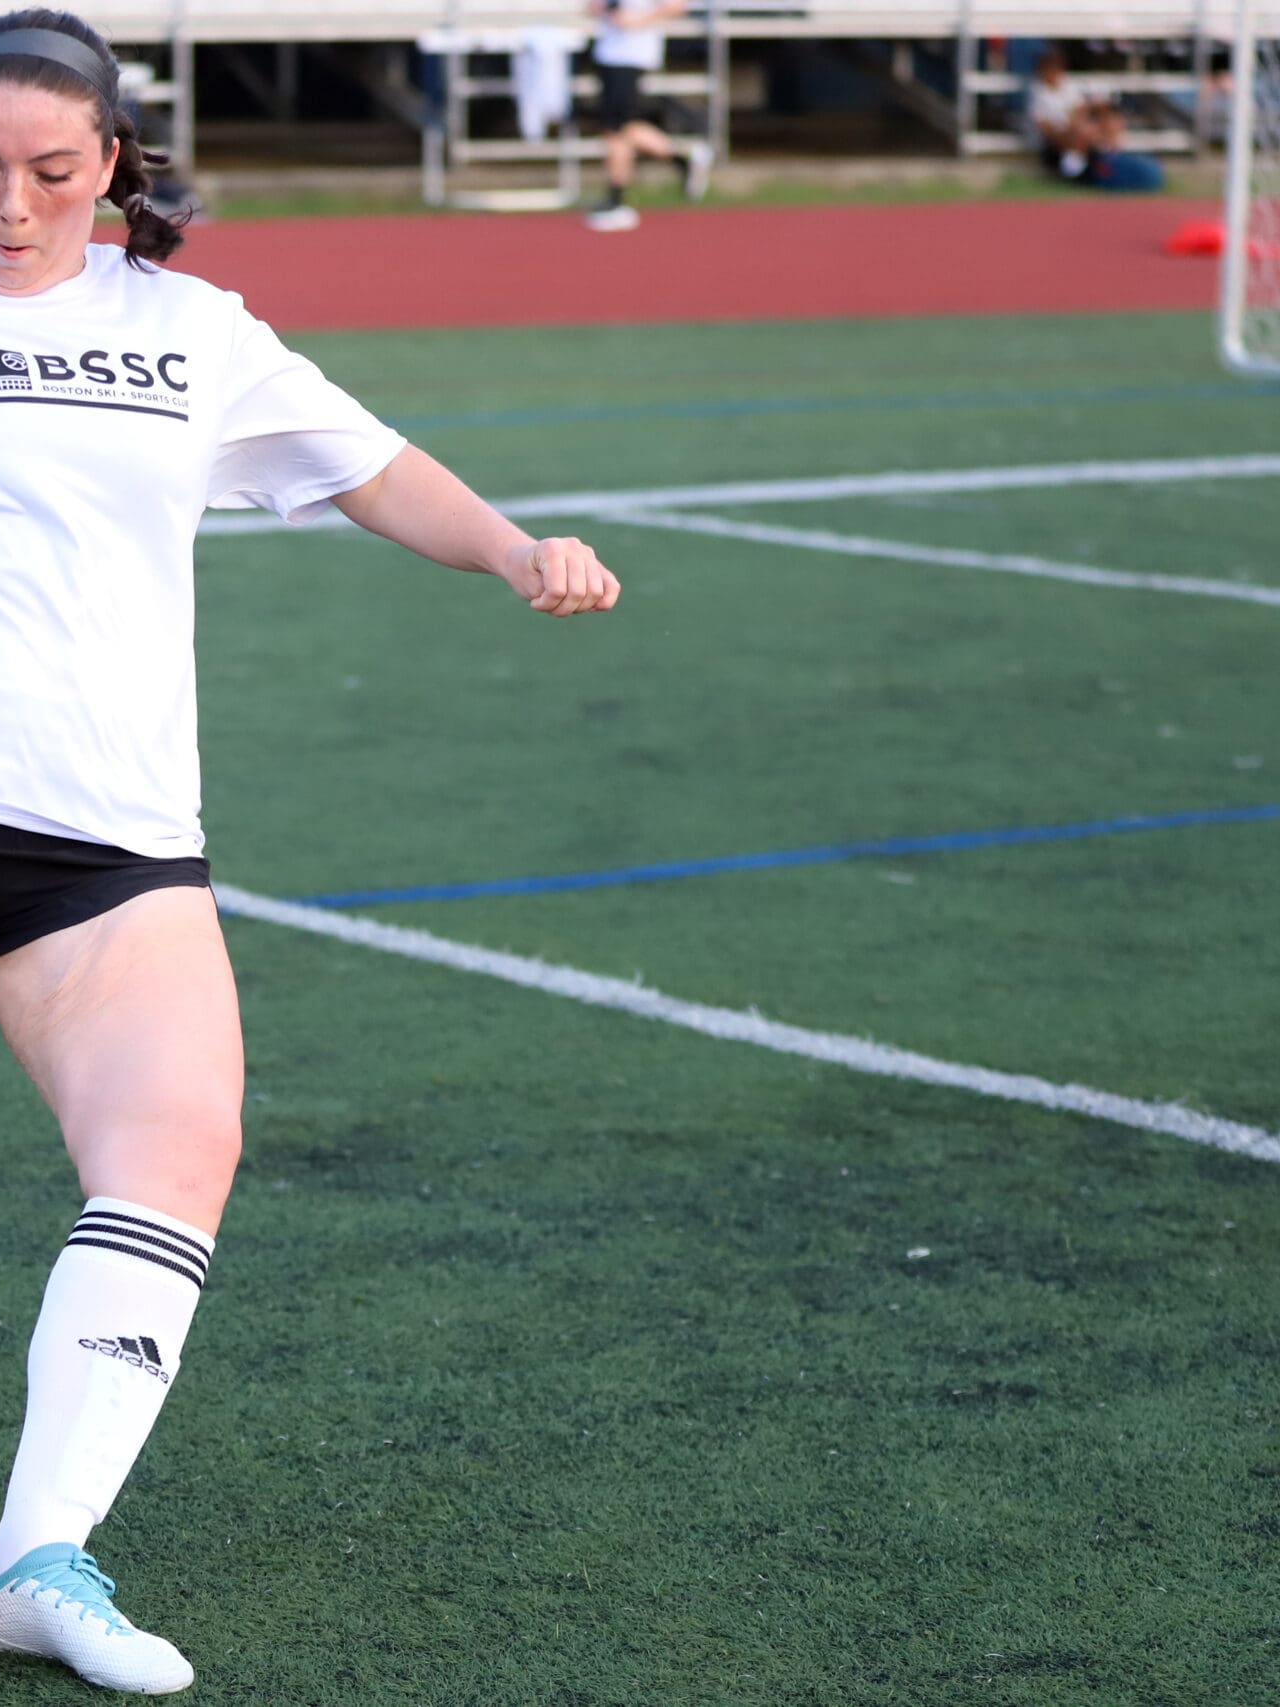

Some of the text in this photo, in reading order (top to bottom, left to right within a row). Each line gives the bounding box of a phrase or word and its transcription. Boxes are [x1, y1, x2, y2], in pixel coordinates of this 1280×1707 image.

[32, 350, 189, 393] BSSC
[42, 384, 93, 396] BOSTON
[97, 388, 117, 398] SKI
[130, 391, 170, 404] SPORTS
[79, 1338, 170, 1384] adidas
